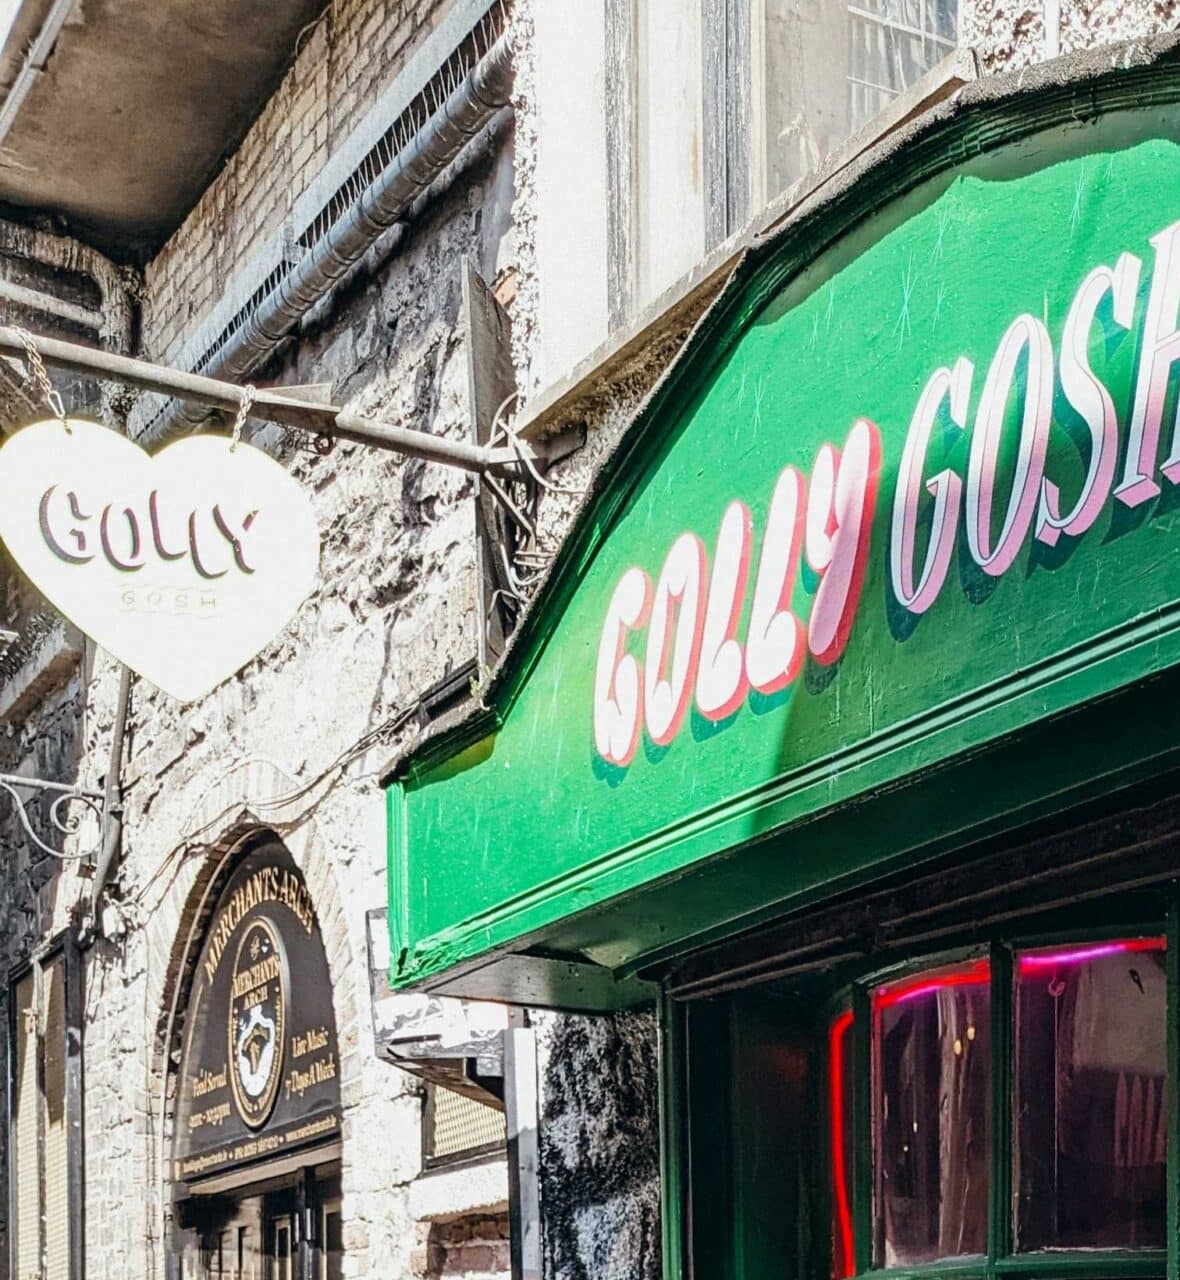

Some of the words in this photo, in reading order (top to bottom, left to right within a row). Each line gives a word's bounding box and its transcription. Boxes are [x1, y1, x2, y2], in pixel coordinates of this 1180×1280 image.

[38, 483, 259, 580] GOLLY
[120, 590, 217, 609] GOSH
[592, 417, 882, 767] GOLLY
[204, 867, 280, 986] MERCHANTS
[279, 870, 315, 936] ARCH
[243, 985, 268, 1010] ARCH
